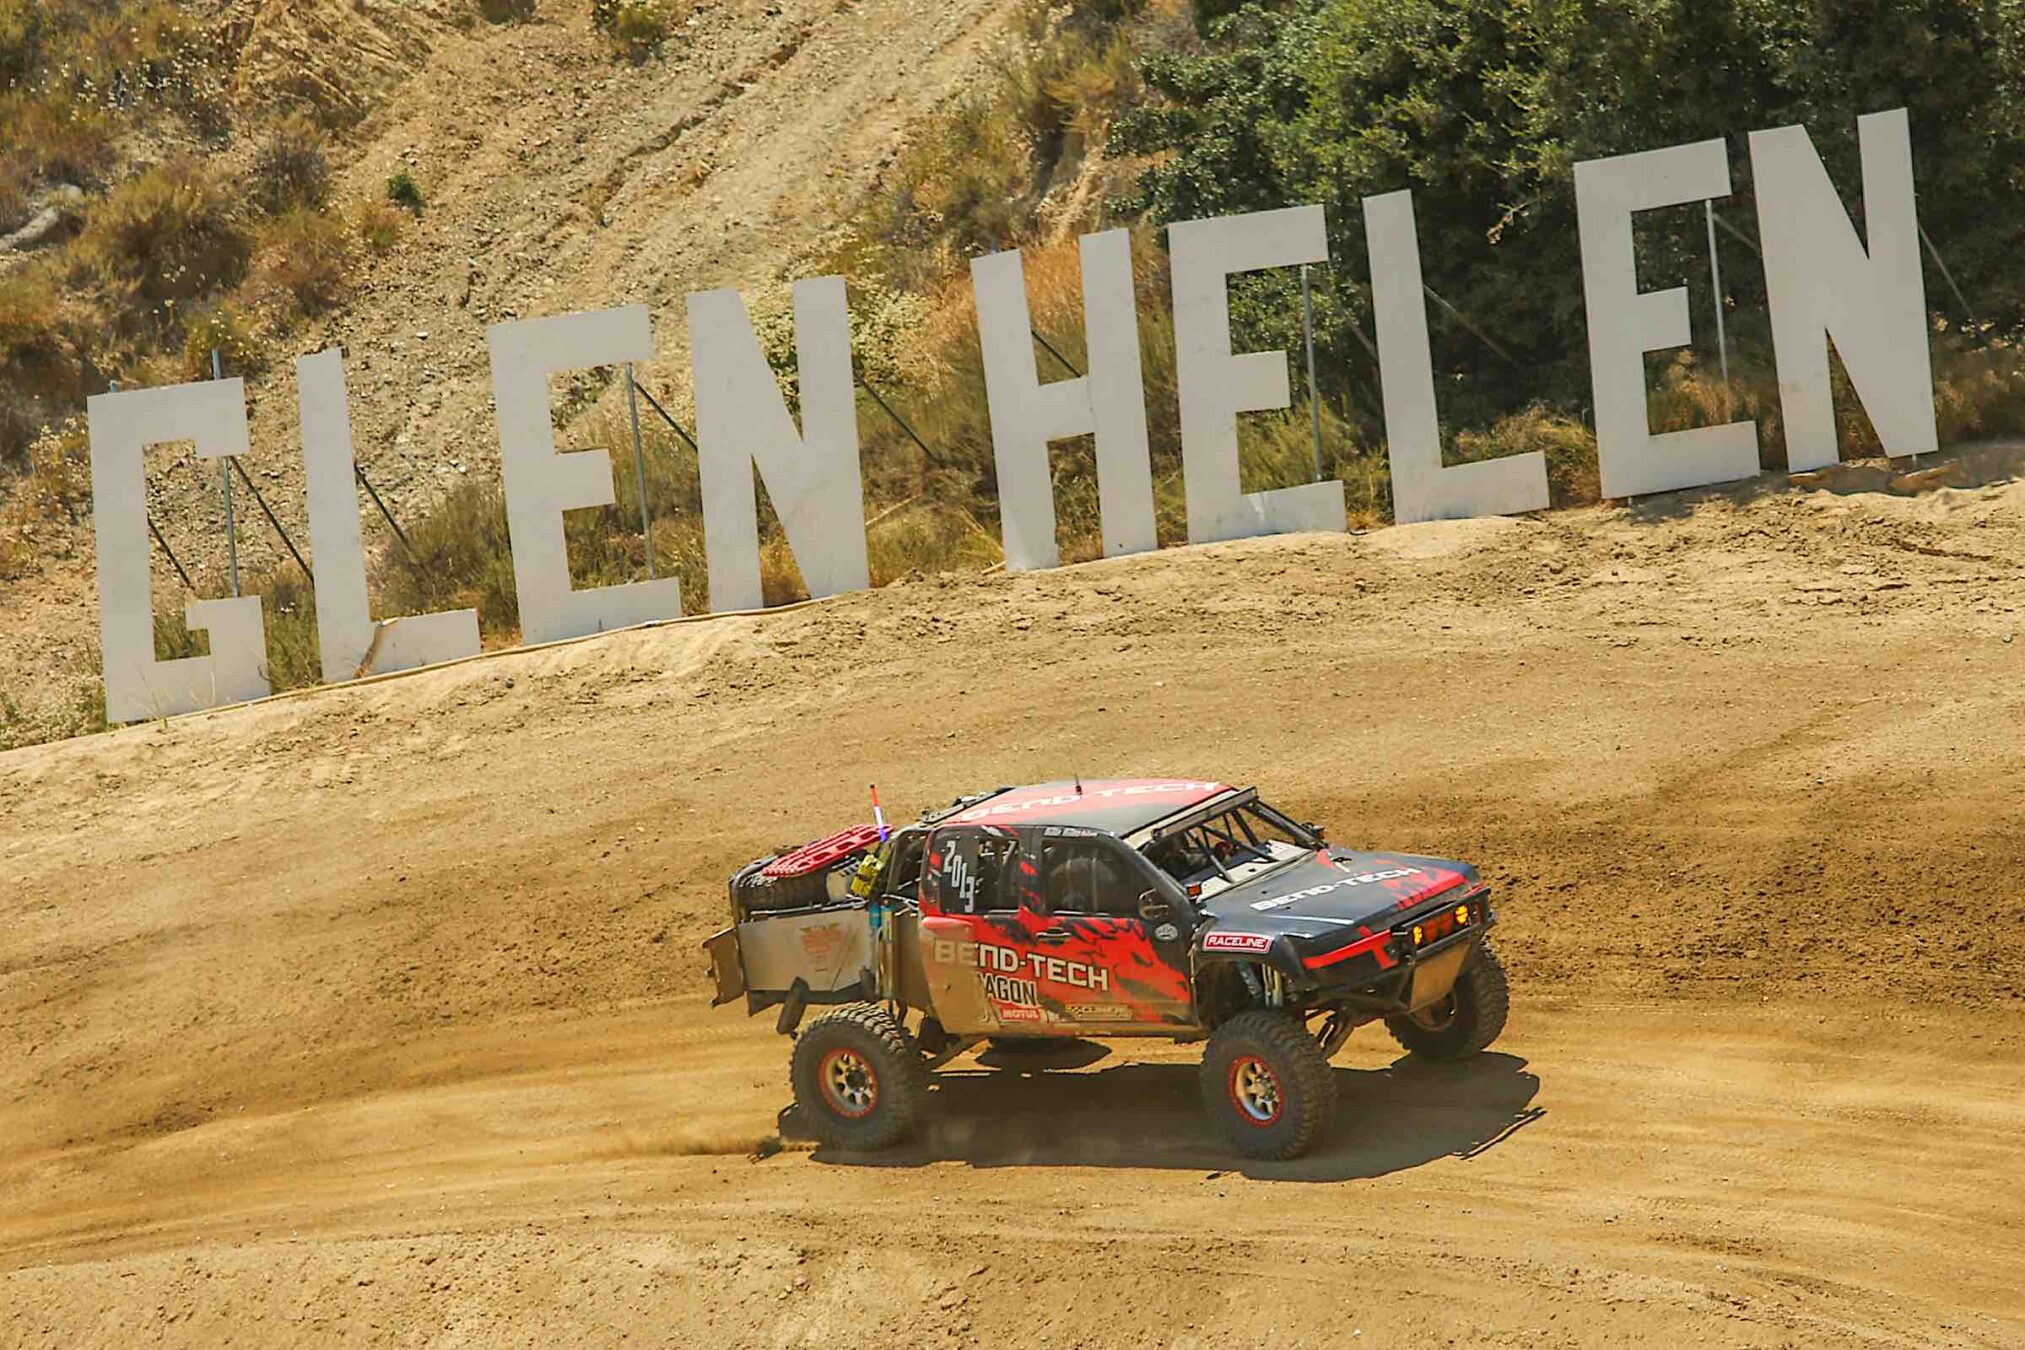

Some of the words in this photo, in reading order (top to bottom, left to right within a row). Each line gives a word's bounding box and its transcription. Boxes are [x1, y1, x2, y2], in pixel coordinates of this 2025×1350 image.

[87, 275, 870, 723] GLEN
[969, 107, 1939, 572] HELEN
[1249, 867, 1422, 911] BEND-TECH
[1207, 936, 1267, 948] RACELINE
[933, 939, 1109, 992] BEND-TECH
[977, 972, 1038, 1007] AGON
[1002, 1008, 1039, 1020] MOTUL
